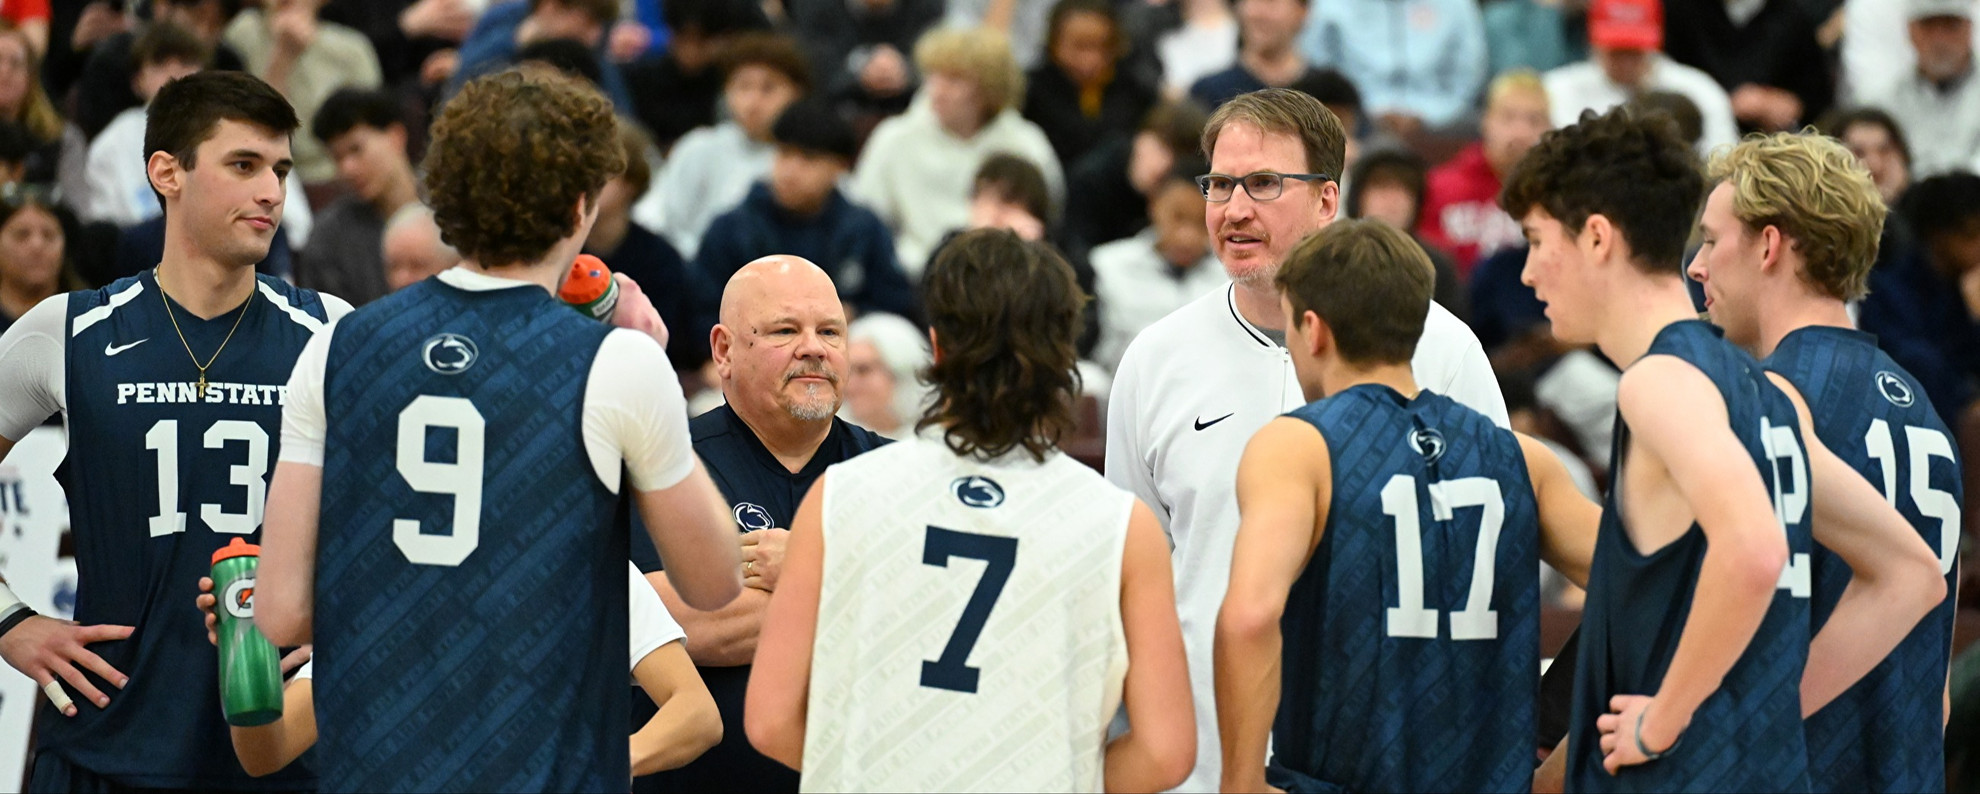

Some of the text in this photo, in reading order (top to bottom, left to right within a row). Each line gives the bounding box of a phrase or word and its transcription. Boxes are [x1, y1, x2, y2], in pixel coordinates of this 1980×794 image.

[117, 382, 197, 405] PENN
[145, 419, 270, 538] 13
[393, 395, 486, 566] 9
[1380, 474, 1505, 640] 17
[1865, 417, 1961, 577] 15
[920, 525, 1019, 694] 7
